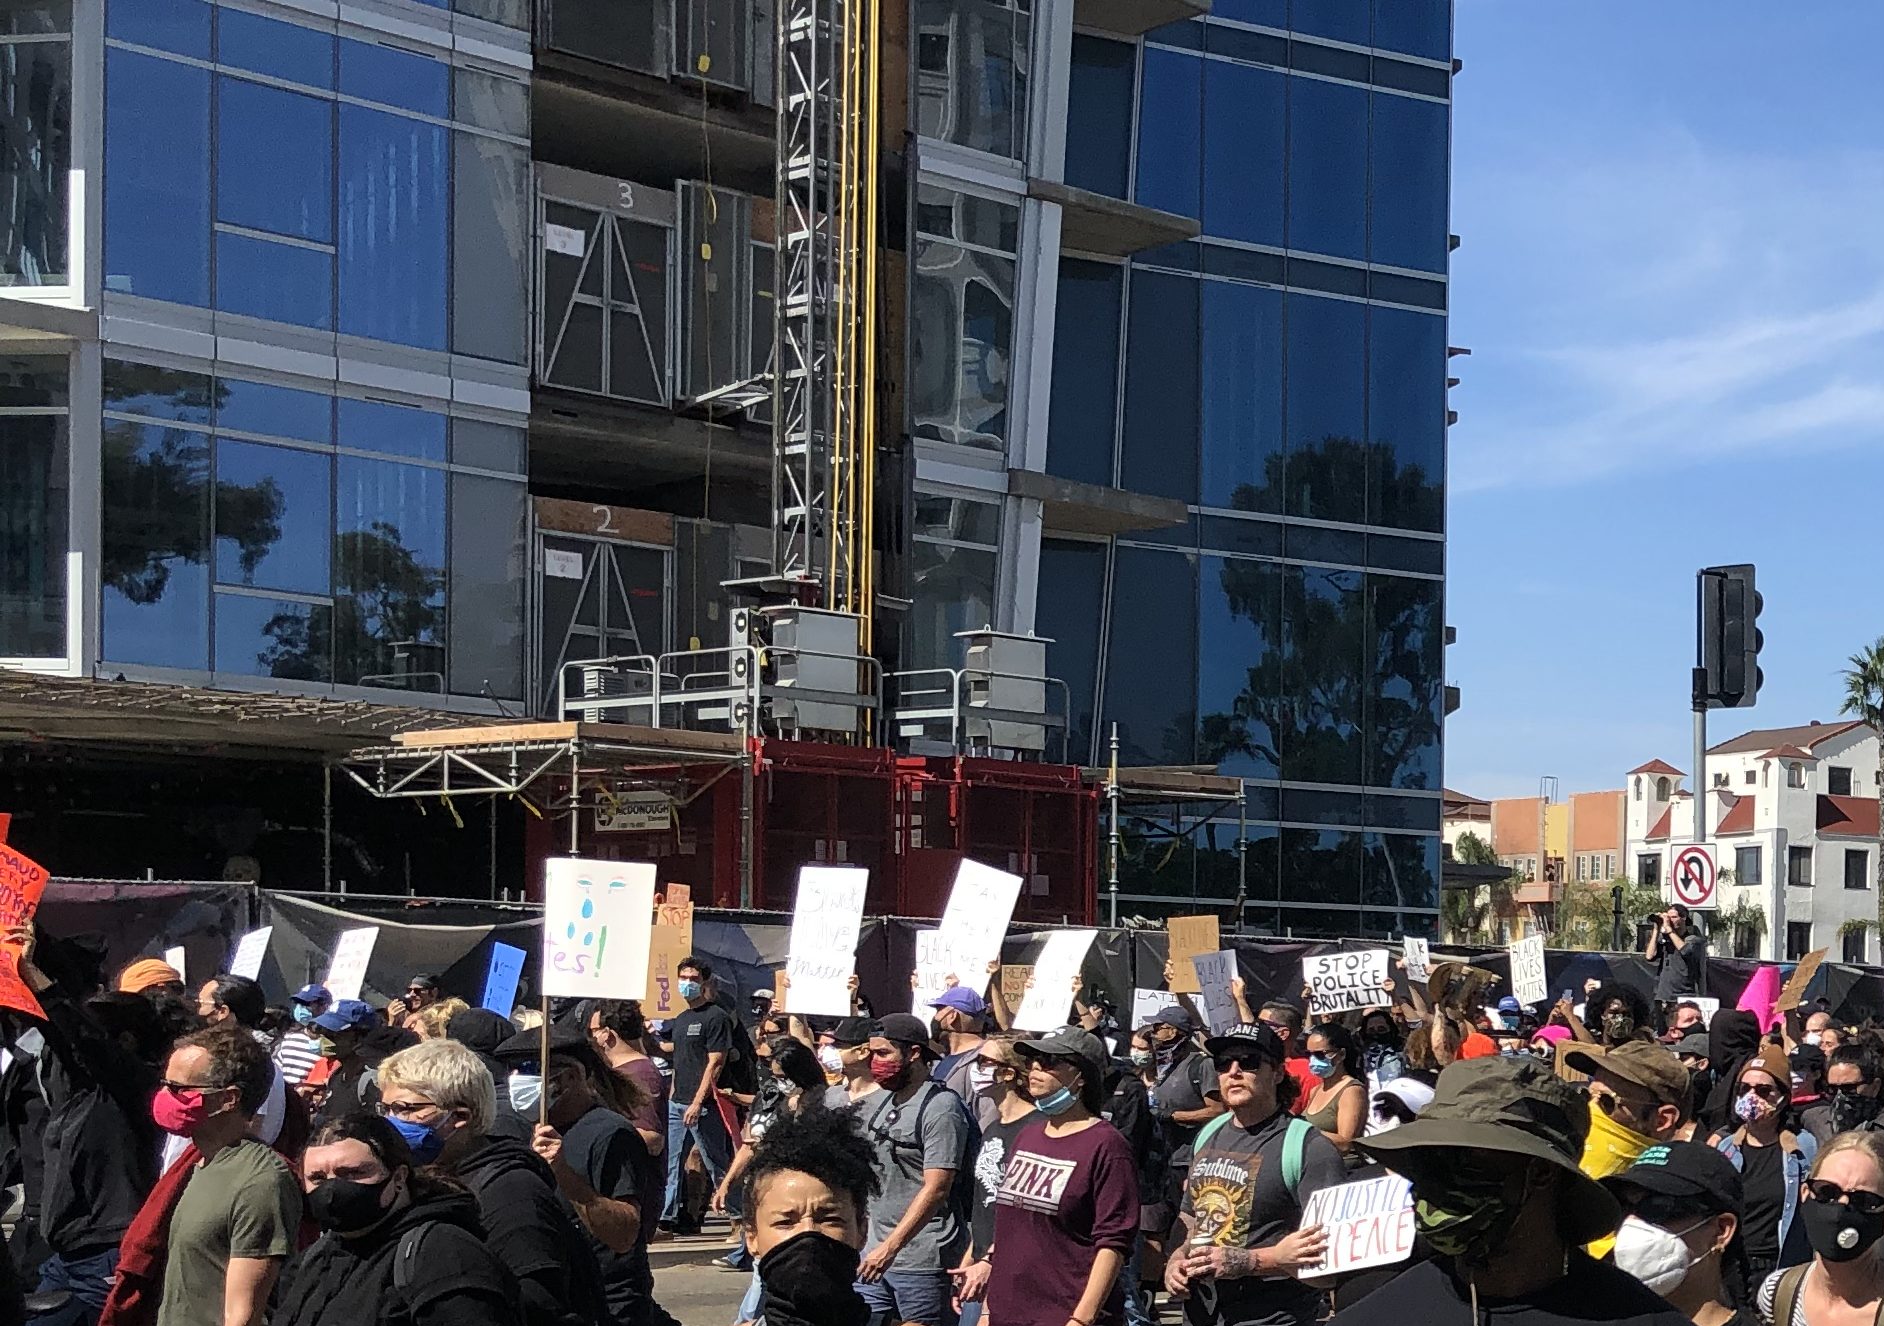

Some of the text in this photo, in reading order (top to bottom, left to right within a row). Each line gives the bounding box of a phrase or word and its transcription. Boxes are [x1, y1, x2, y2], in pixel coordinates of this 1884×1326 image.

[617, 181, 634, 209] 3
[590, 504, 622, 535] 2
[1319, 953, 1372, 974] STOP
[1512, 938, 1541, 962] BLACK
[1312, 969, 1382, 992] POLICE
[1513, 956, 1543, 982] LIVES
[1310, 989, 1391, 1013] BRUTALITY
[1515, 979, 1546, 1003] MATTER
[1005, 1159, 1065, 1200] PINK
[1192, 1157, 1250, 1185] Sublime
[1335, 1178, 1414, 1223] JUSTICE
[1334, 1207, 1414, 1268] PEACE
